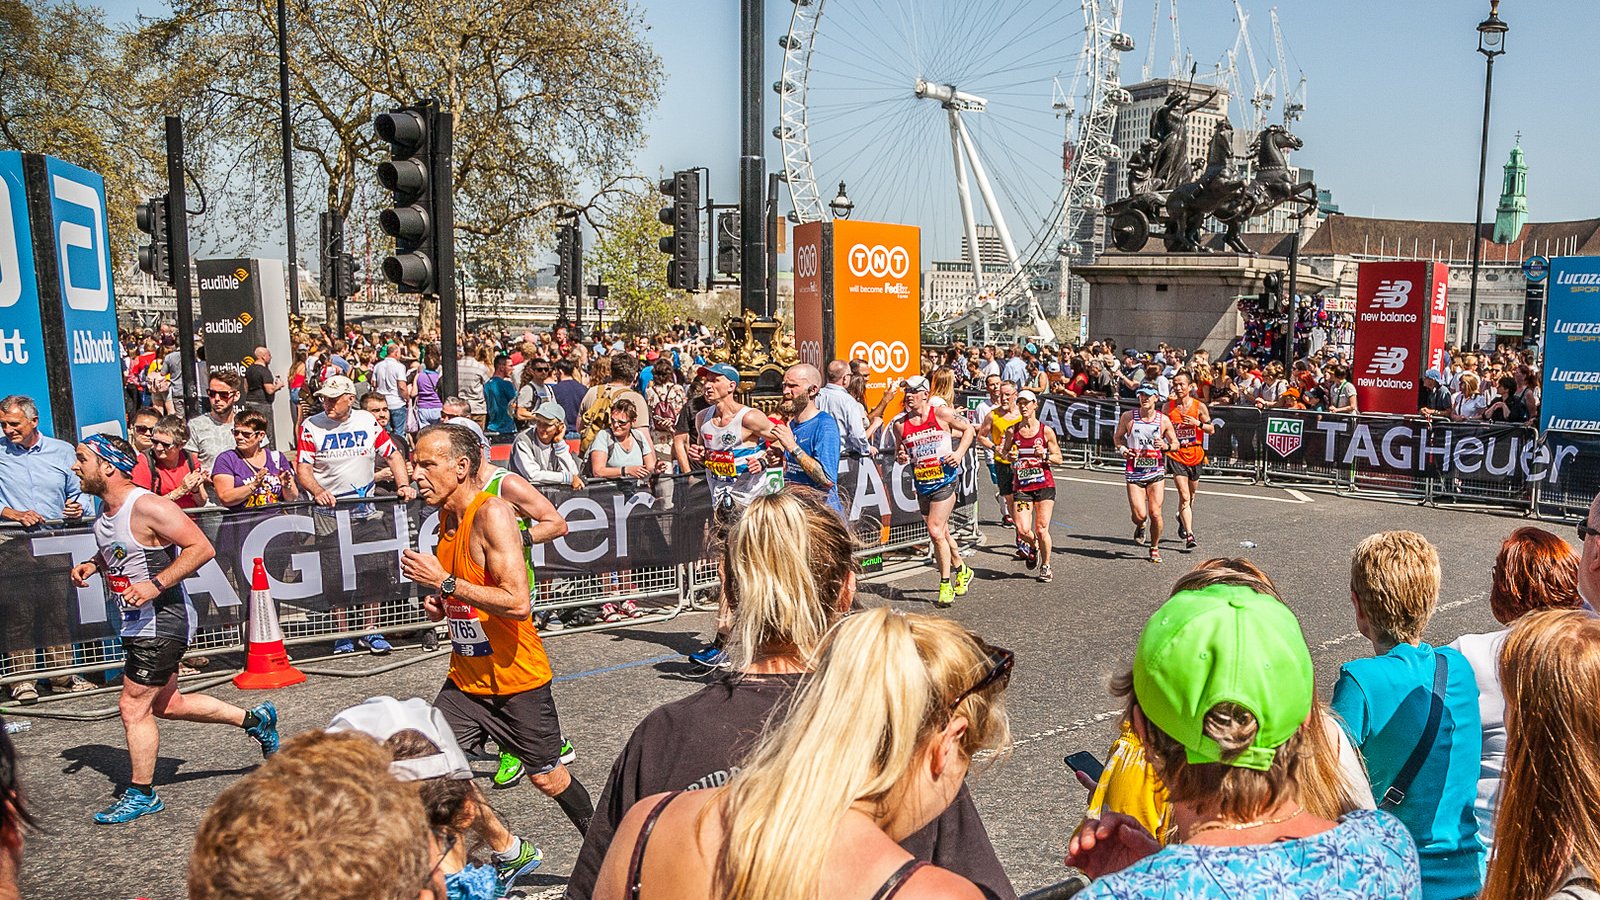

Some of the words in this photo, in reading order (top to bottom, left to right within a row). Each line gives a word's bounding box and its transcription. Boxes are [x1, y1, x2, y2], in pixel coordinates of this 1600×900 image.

[852, 248, 906, 274] TNT
[201, 275, 239, 290] audible
[860, 285, 883, 293] become
[1361, 312, 1379, 322] new
[1380, 311, 1417, 323] balance
[205, 319, 243, 334] audible
[73, 330, 115, 364] Abbott
[1550, 367, 1600, 383] Lucoza
[865, 381, 886, 389] ecome
[1357, 377, 1375, 386] new
[1376, 377, 1413, 390] balance
[1564, 383, 1600, 391] SPORT
[1271, 420, 1300, 434] TAG
[1268, 435, 1300, 454] HEUER
